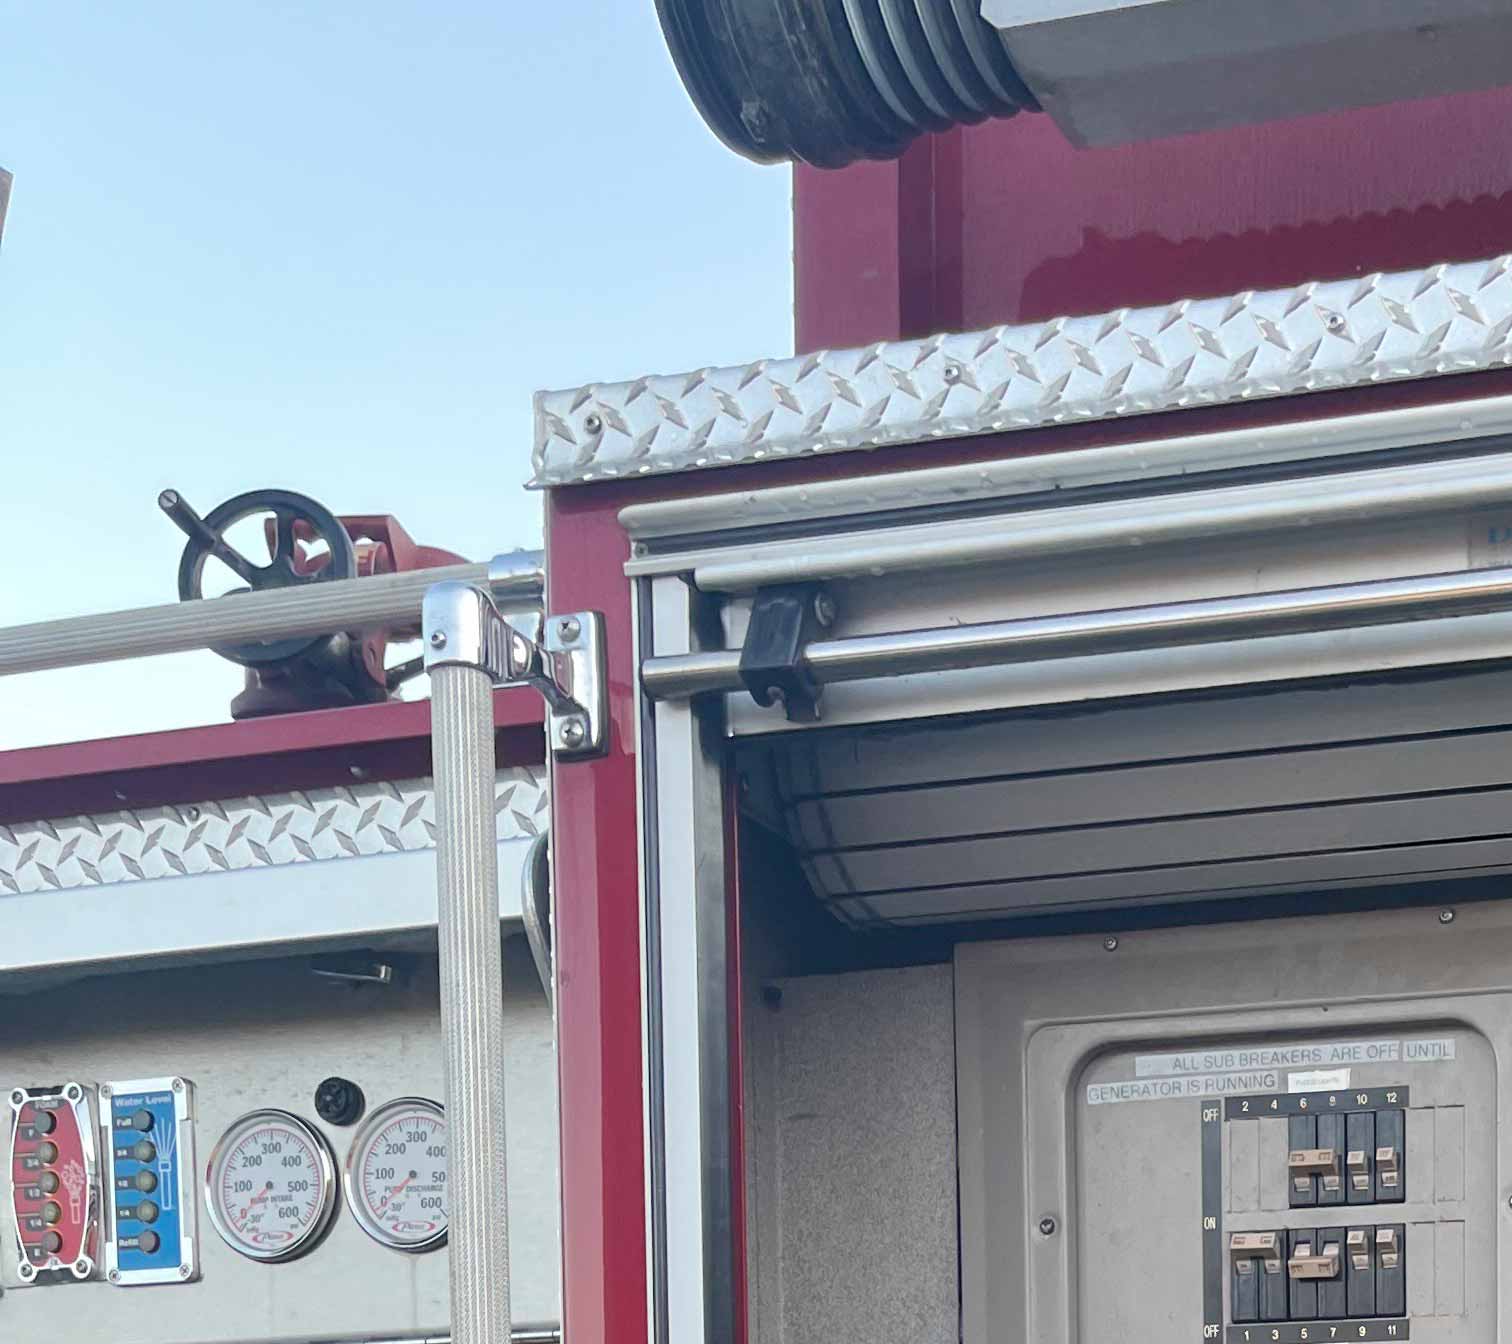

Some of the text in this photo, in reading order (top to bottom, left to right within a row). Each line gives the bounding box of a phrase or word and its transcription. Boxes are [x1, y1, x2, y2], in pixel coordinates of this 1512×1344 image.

[1173, 1043, 1451, 1070] ALL SUB BREAKERS ARE OFF UNTIL
[1088, 1080, 1182, 1100] GENERATOR
[1186, 1080, 1201, 1093] IS
[1204, 1073, 1275, 1092] RUNNING
[115, 1094, 173, 1107] Water Level
[1299, 1097, 1308, 1109] 6
[1356, 1093, 1368, 1105] 10
[1386, 1091, 1397, 1103] 12
[1242, 1101, 1249, 1112] 2
[1270, 1099, 1279, 1110] 4
[1202, 1109, 1219, 1122] OFF
[406, 1130, 427, 1142] 300
[261, 1142, 281, 1153] 300
[385, 1143, 406, 1154] 200
[426, 1145, 446, 1157] 400
[242, 1155, 262, 1167] 200
[281, 1155, 301, 1167] 400
[375, 1167, 395, 1179] 100
[432, 1171, 446, 1182] 50
[234, 1181, 252, 1192] 100
[287, 1180, 308, 1192] 500
[407, 1184, 443, 1193] DISCHARGE
[381, 1196, 388, 1207] 0
[421, 1197, 442, 1209] 600
[240, 1208, 247, 1218] 0
[278, 1206, 299, 1218] 600
[1203, 1217, 1216, 1230] ON
[1203, 1325, 1220, 1338] OFF
[1244, 1330, 1250, 1341] 1
[1271, 1329, 1280, 1340] 3
[1301, 1328, 1308, 1338] 5
[1330, 1327, 1338, 1338] 7
[1358, 1326, 1367, 1337] 9
[1387, 1325, 1398, 1336] 11
